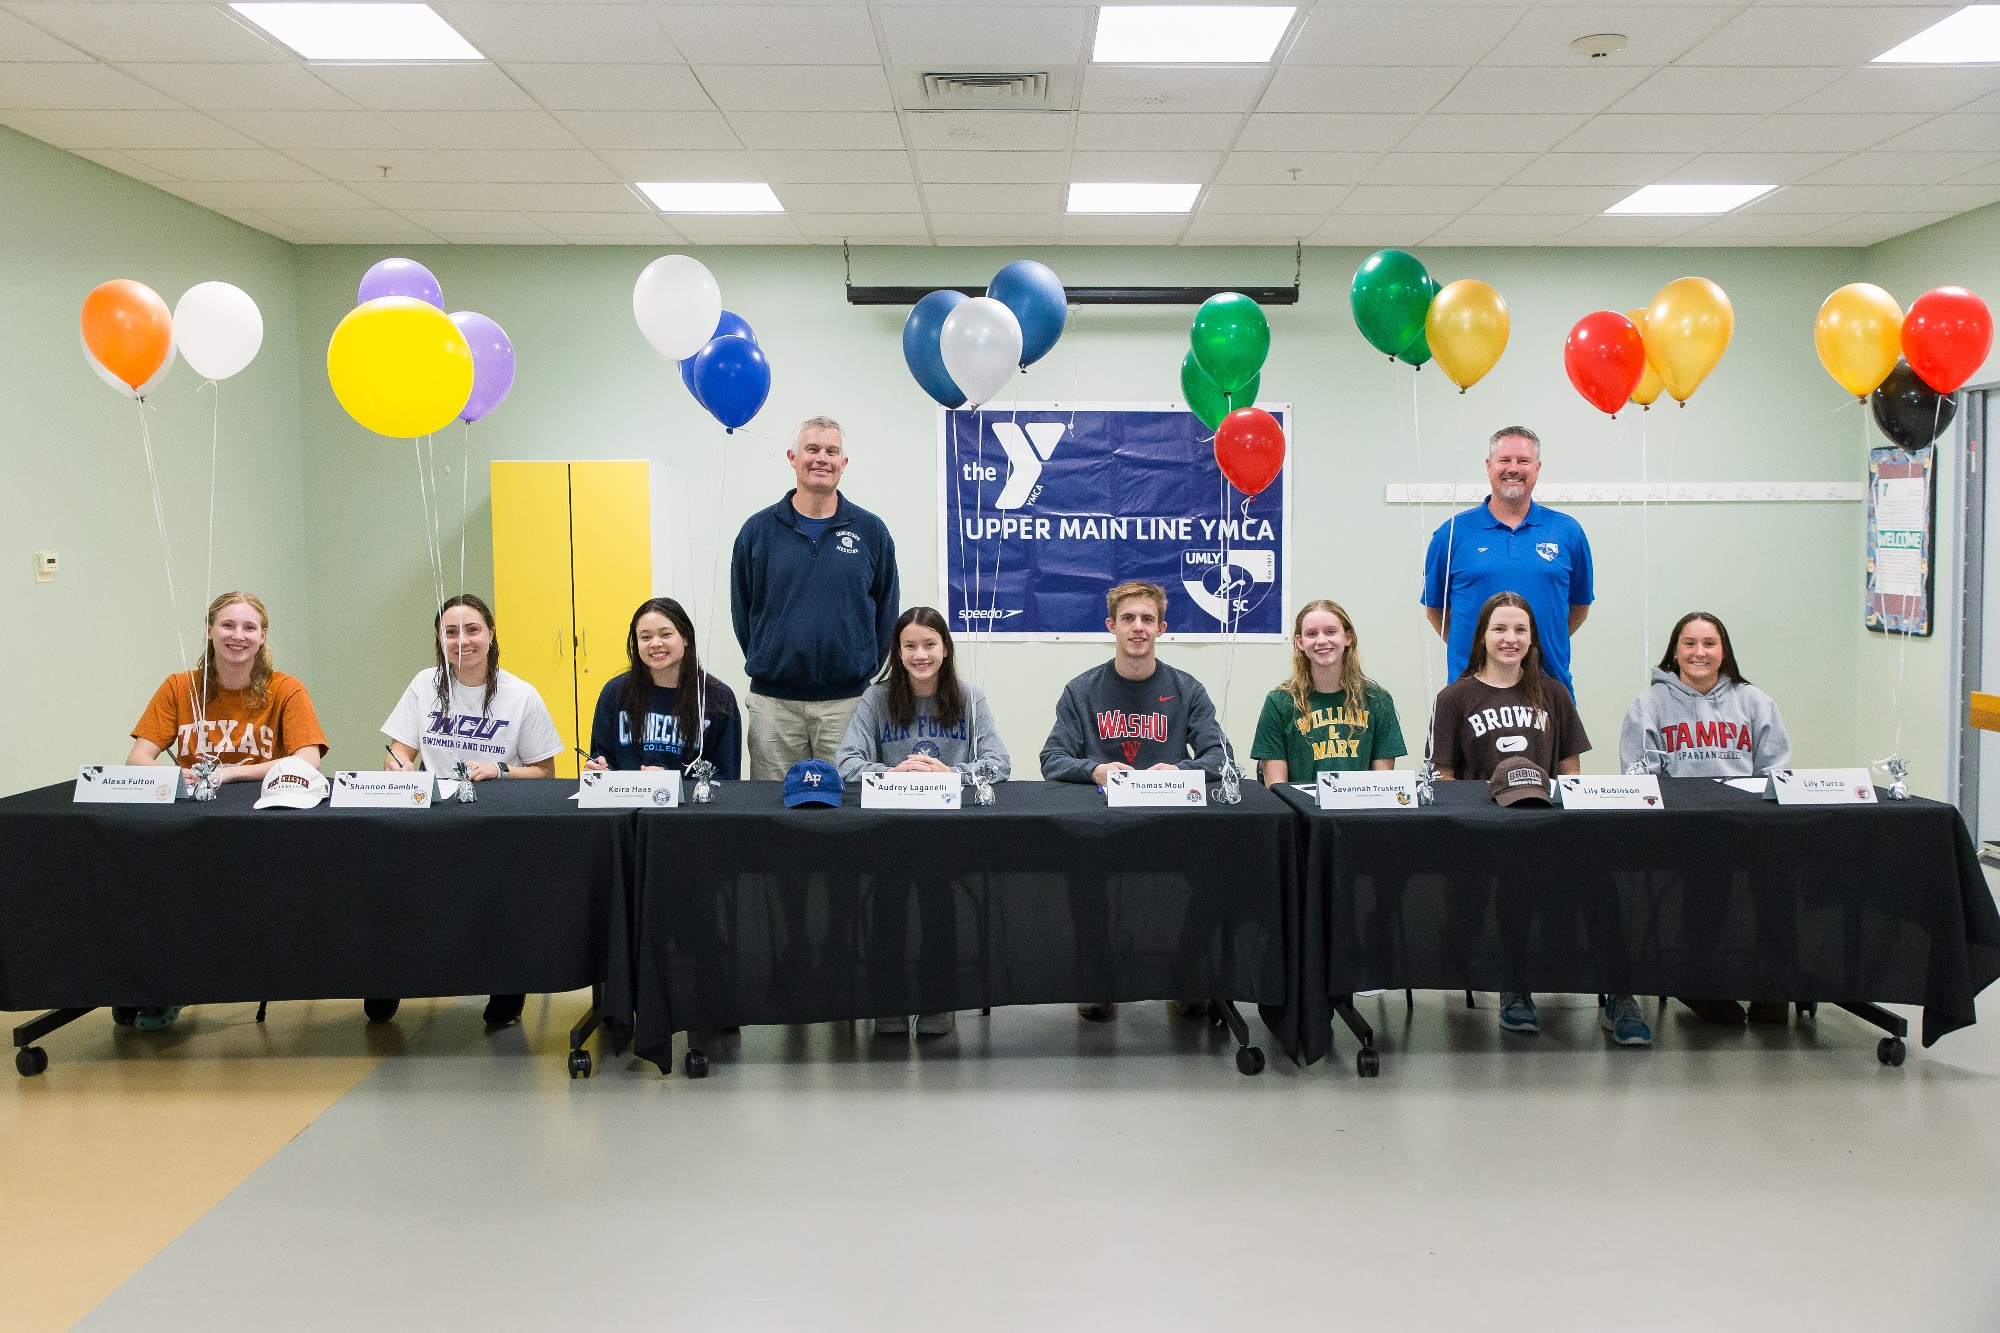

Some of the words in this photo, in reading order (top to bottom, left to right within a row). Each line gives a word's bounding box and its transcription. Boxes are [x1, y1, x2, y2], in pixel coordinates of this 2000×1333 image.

[962, 462, 997, 481] the
[1026, 484, 1044, 506] YMCA
[966, 518, 1051, 540] UPPER
[1059, 518, 1128, 540] MAIN
[1136, 518, 1192, 540] LINE
[1200, 518, 1275, 541] YMCA
[1878, 530, 1922, 548] WELCOME
[1185, 552, 1222, 564] UMLY
[958, 608, 1003, 620] speedo
[1232, 600, 1249, 611] SC
[427, 711, 510, 740] WCU
[1297, 707, 1369, 735] WILLIAM
[1468, 706, 1548, 737] BROWN
[178, 720, 274, 759] TEXAS
[881, 720, 911, 743] AIR
[1329, 725, 1340, 739] &
[1660, 721, 1752, 753] TAMPA
[422, 737, 460, 748] SWIMMING
[462, 742, 478, 751] AND
[480, 744, 506, 754] DIVING
[643, 744, 682, 755] COLLEGE
[1312, 740, 1360, 760] MARY
[280, 774, 310, 789] CHESTER
[803, 770, 821, 787] AF
[1508, 769, 1541, 781] BROWN
[878, 784, 908, 792] Audrey
[910, 784, 947, 792] Laganelli
[1583, 787, 1598, 795] Lily
[1803, 780, 1818, 788] Lily
